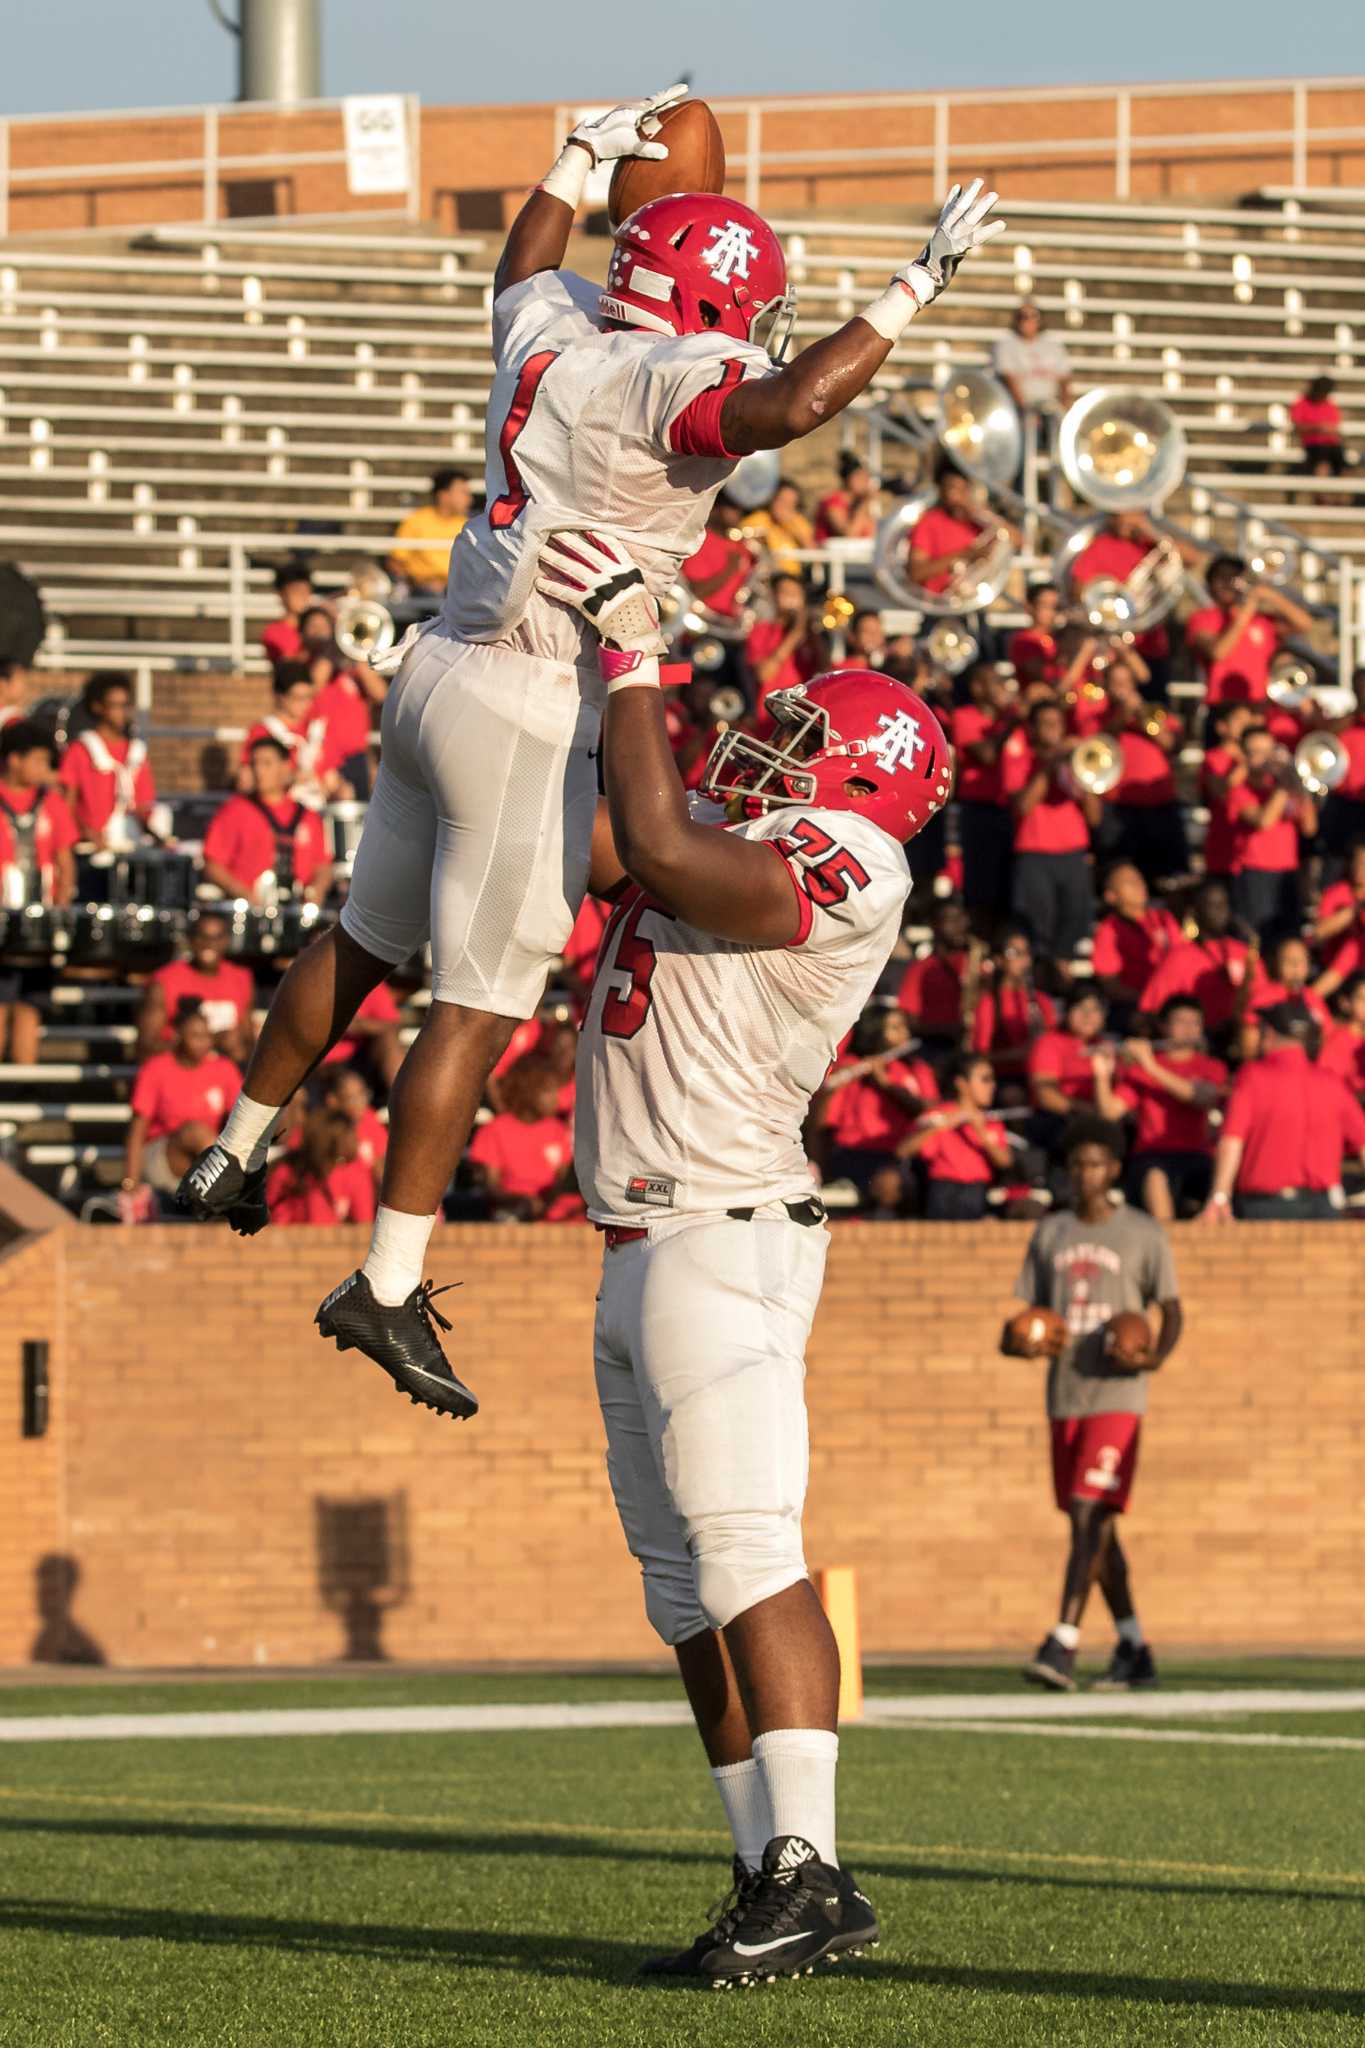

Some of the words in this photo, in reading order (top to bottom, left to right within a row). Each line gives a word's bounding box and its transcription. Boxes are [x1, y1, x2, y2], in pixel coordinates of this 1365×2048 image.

[489, 349, 562, 531] 1
[772, 816, 872, 908] 75
[189, 1146, 230, 1198] NIKE
[648, 1182, 670, 1194] XXL
